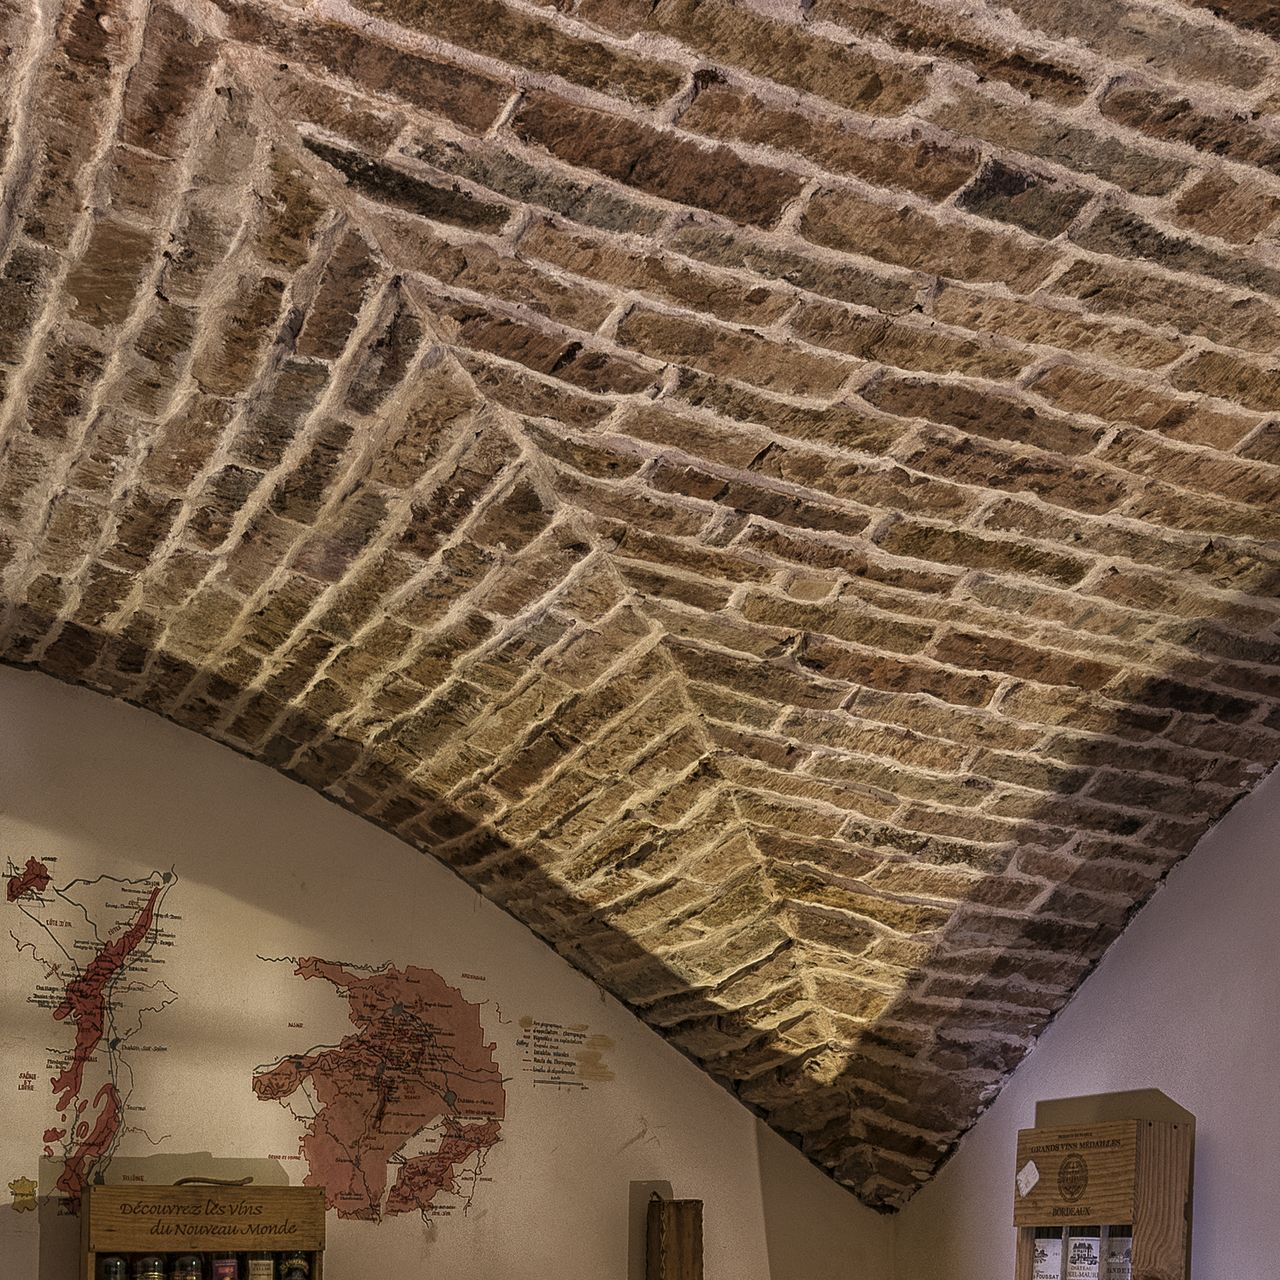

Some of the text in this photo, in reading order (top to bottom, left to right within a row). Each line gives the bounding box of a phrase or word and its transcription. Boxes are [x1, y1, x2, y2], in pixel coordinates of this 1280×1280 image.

[1031, 1143, 1060, 1153] GRANDS
[1060, 1142, 1078, 1150] VINS
[119, 1200, 202, 1217] Découvrez
[204, 1199, 226, 1216] les
[1052, 1206, 1091, 1217] BORDEAUX
[150, 1218, 298, 1236] du Nouveau Monde
